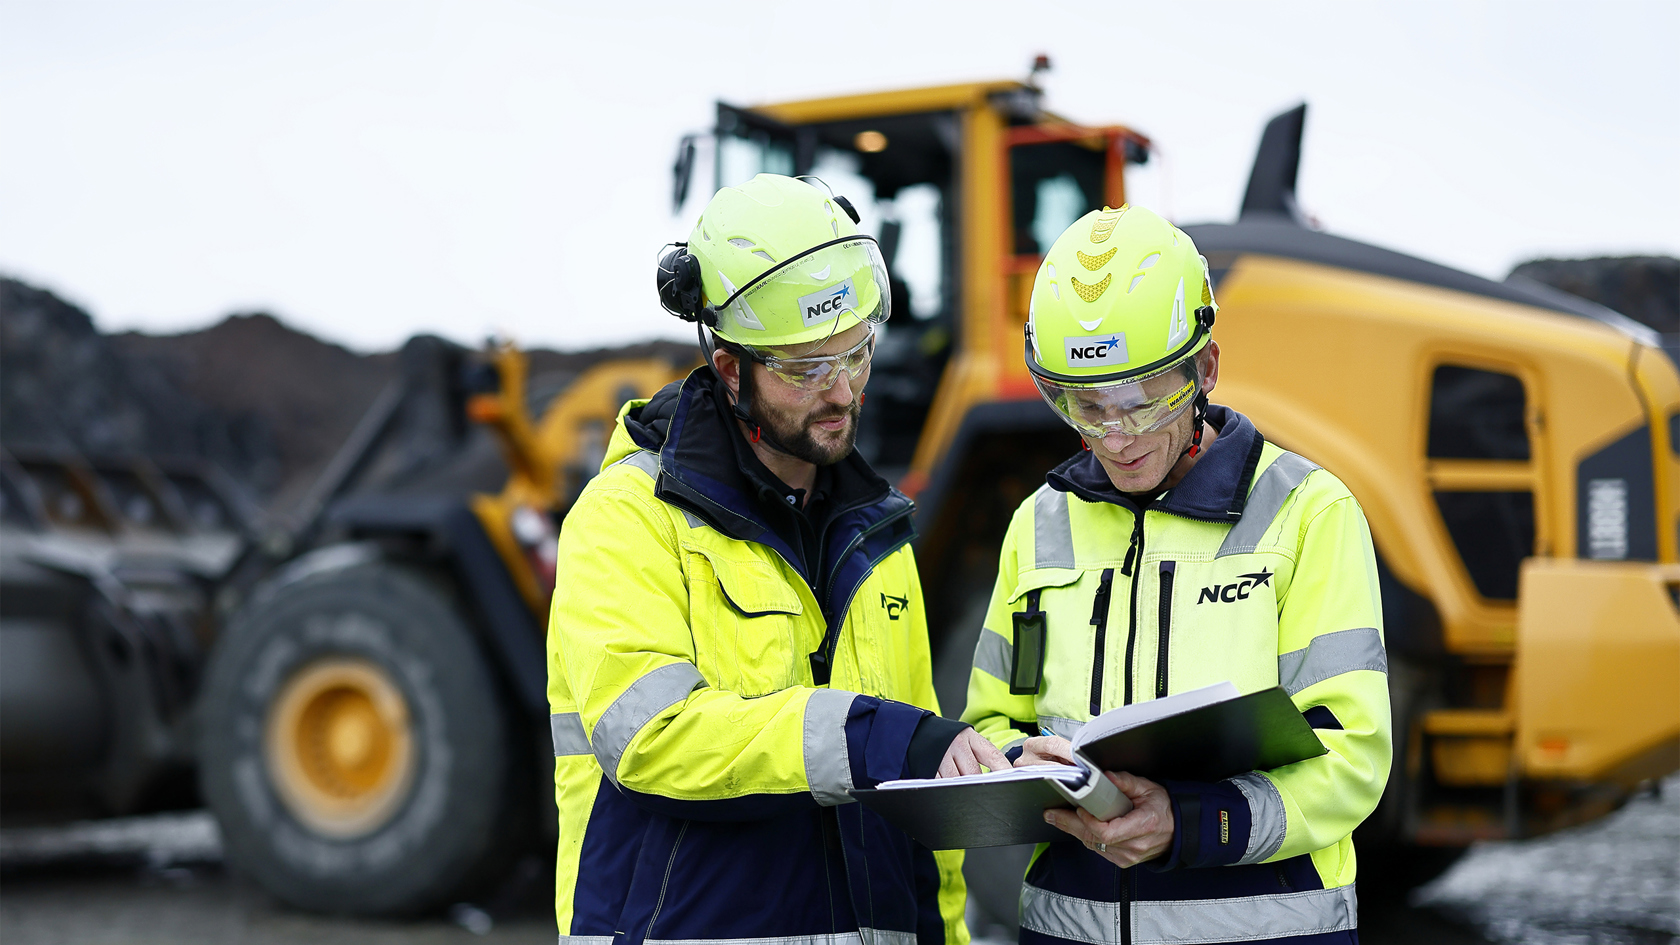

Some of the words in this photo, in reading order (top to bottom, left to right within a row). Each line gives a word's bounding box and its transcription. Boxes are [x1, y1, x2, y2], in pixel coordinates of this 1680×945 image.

[806, 295, 842, 319] NCC
[1071, 345, 1107, 360] NCC
[1169, 385, 1194, 407] WARNING
[1196, 580, 1252, 605] NCC
